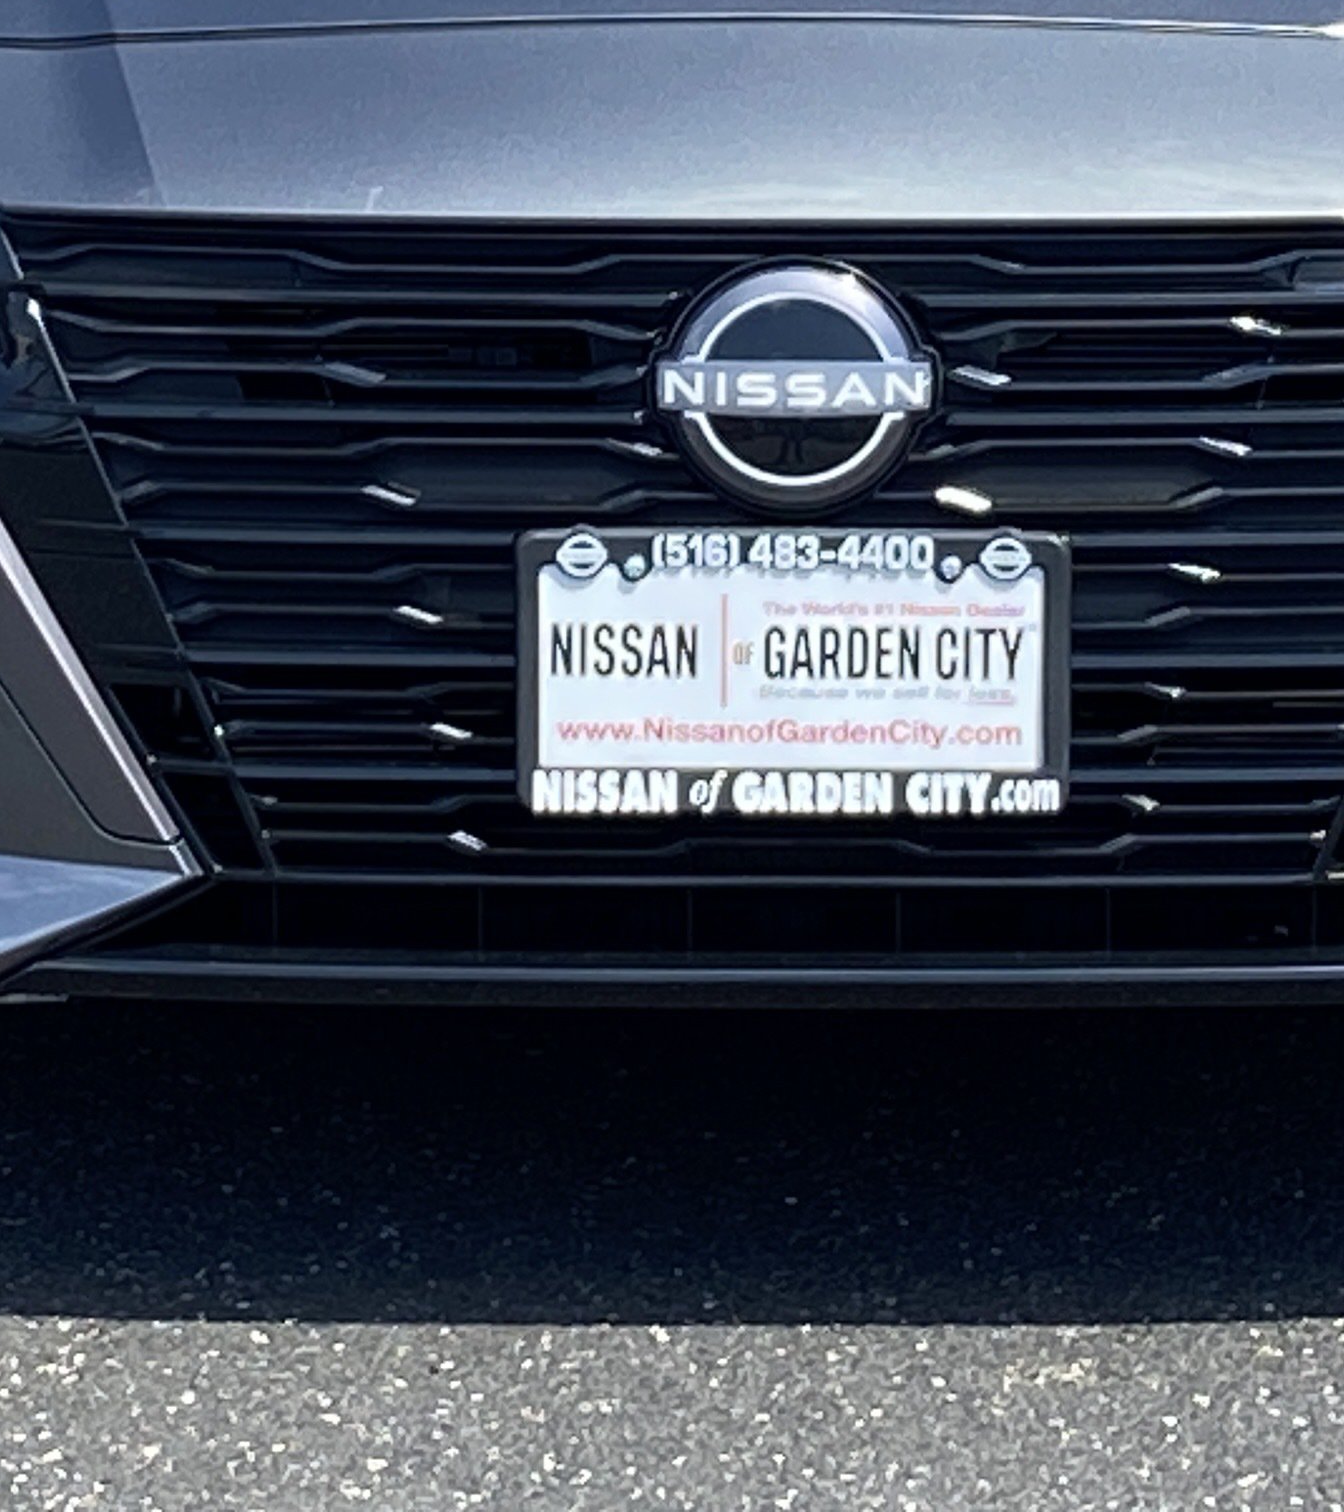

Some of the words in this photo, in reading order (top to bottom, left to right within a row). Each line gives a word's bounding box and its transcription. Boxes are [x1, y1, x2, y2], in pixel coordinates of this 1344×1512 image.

[663, 369, 925, 408] NISSAN
[652, 533, 741, 569] (516)
[748, 534, 935, 570] 483-4400
[762, 601, 797, 617] The
[550, 623, 699, 678] NISSAN
[764, 625, 920, 680] GARDEN
[935, 626, 1024, 681] CITY
[556, 717, 1023, 749] www.NissanofGardenCity.com
[532, 768, 679, 814] NISSAN
[689, 769, 728, 814] of
[732, 770, 894, 814] GARDEN
[906, 771, 1061, 814] CITY.com
